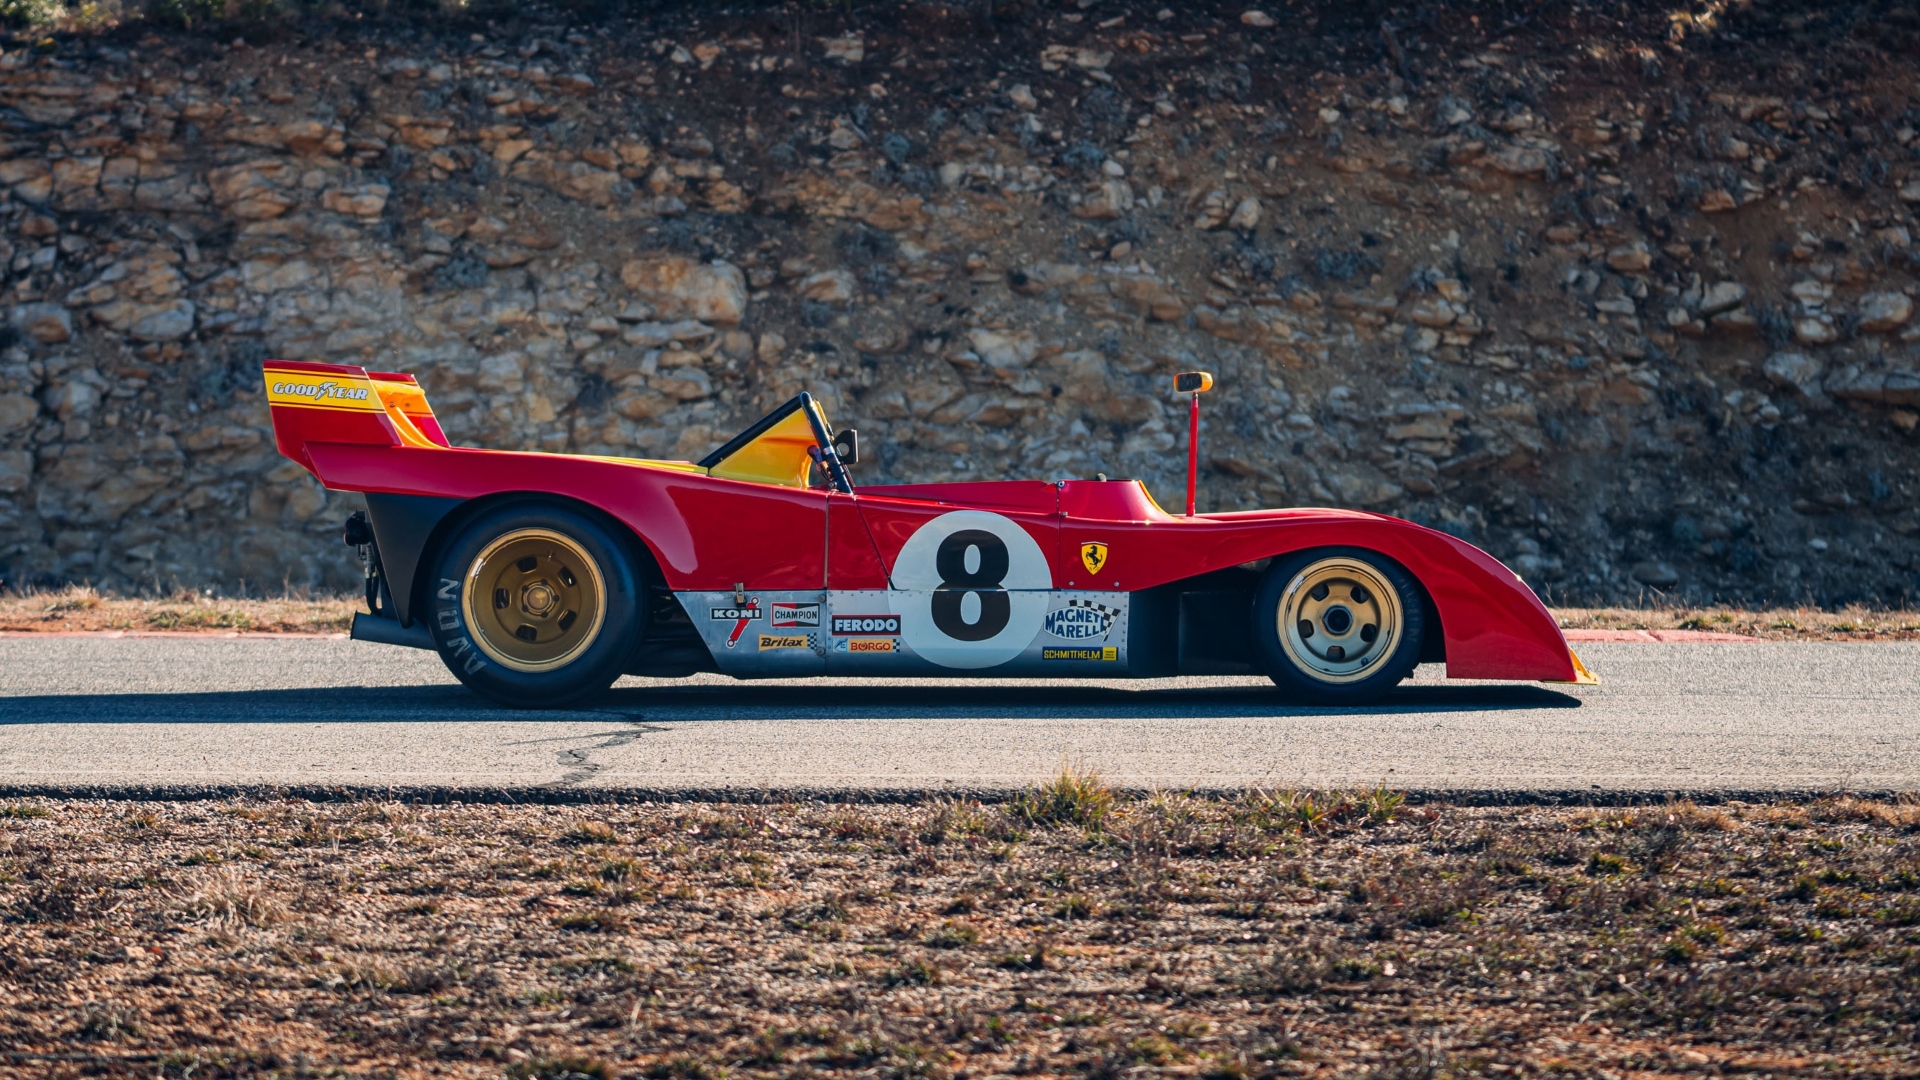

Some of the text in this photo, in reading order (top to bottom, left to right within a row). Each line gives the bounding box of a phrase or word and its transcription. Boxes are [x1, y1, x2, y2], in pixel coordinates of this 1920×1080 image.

[273, 381, 369, 400] GOODYEAR
[931, 529, 1011, 642] 8
[713, 609, 760, 618] KONI
[774, 610, 818, 619] CHAMPION
[437, 578, 487, 675] AVON
[834, 618, 898, 632] FERODO
[760, 637, 803, 648] Britax
[850, 642, 891, 651] BORGO
[1044, 650, 1100, 659] SCHMITTHELM
